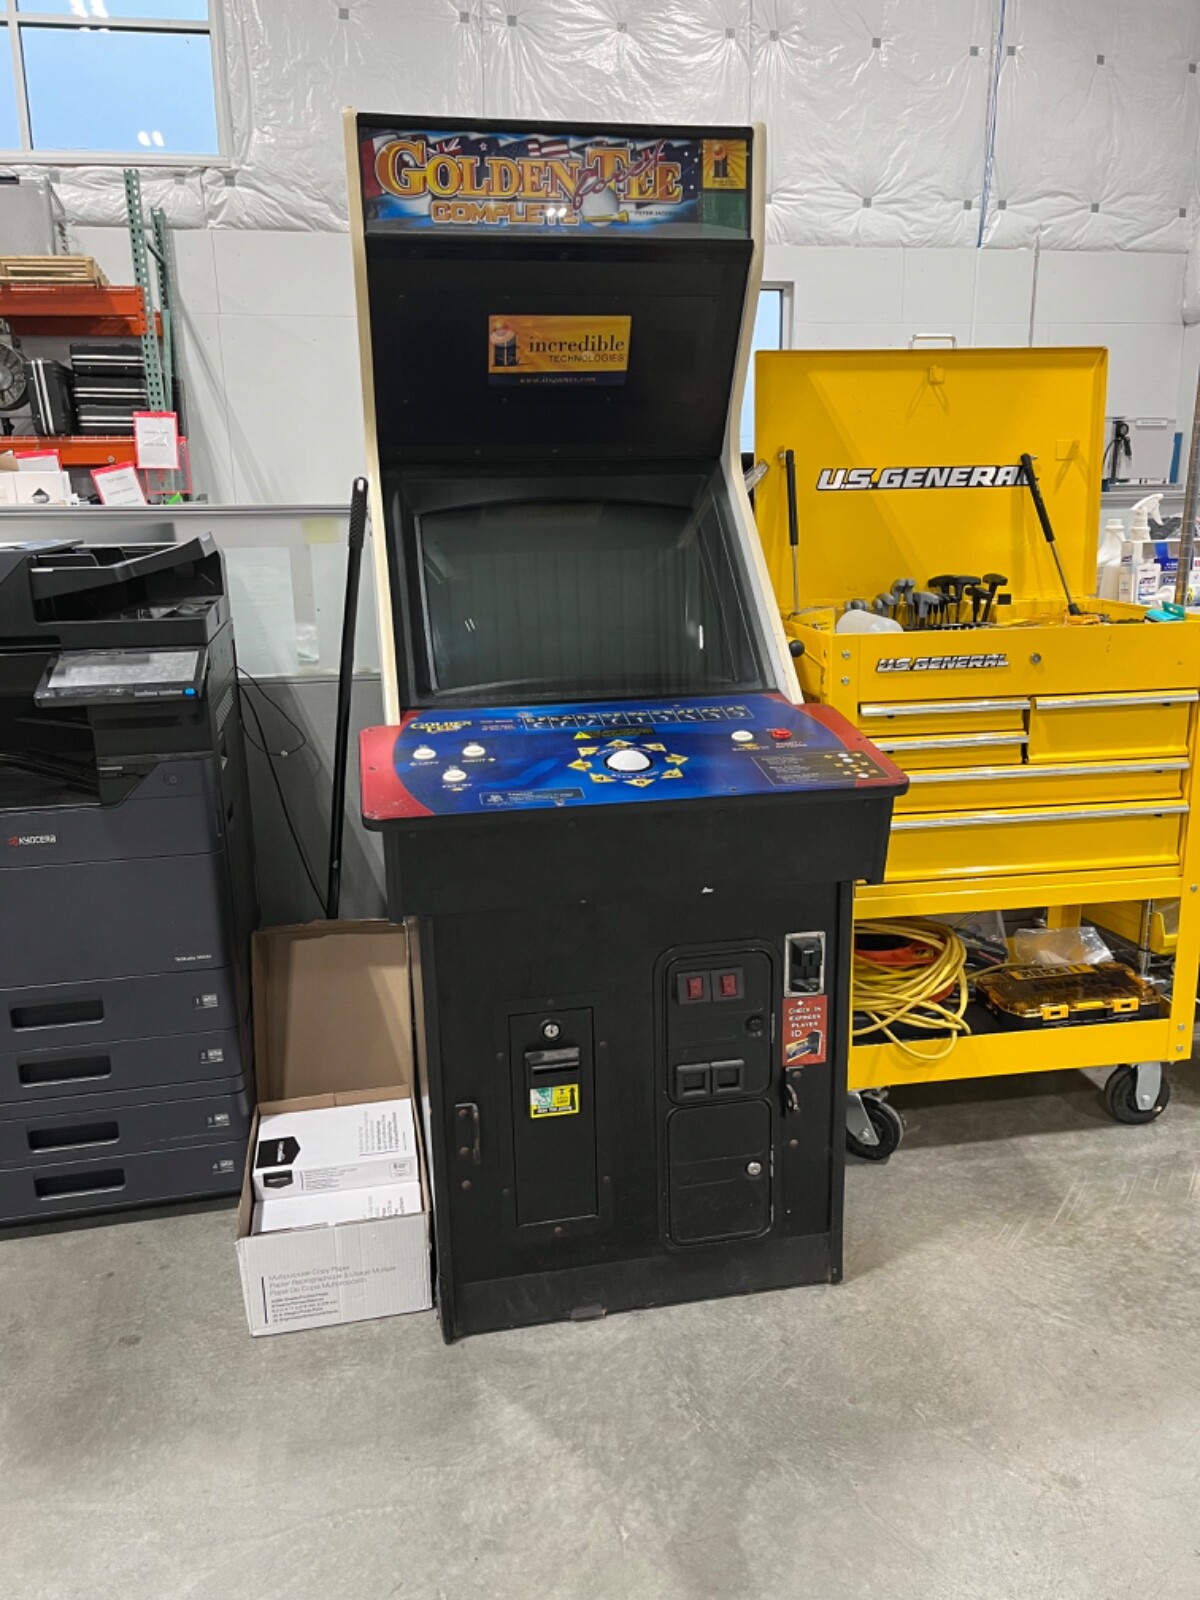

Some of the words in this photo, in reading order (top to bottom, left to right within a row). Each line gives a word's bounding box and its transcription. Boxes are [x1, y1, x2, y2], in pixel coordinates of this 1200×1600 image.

[375, 140, 581, 199] GOLDEN
[586, 147, 683, 203] TEE
[431, 201, 580, 225] COMPLETE
[529, 335, 625, 353] incredible
[549, 353, 625, 363] TECHNOLOGIES
[19, 834, 57, 845] KYOCERA
[791, 1029, 802, 1037] ID
